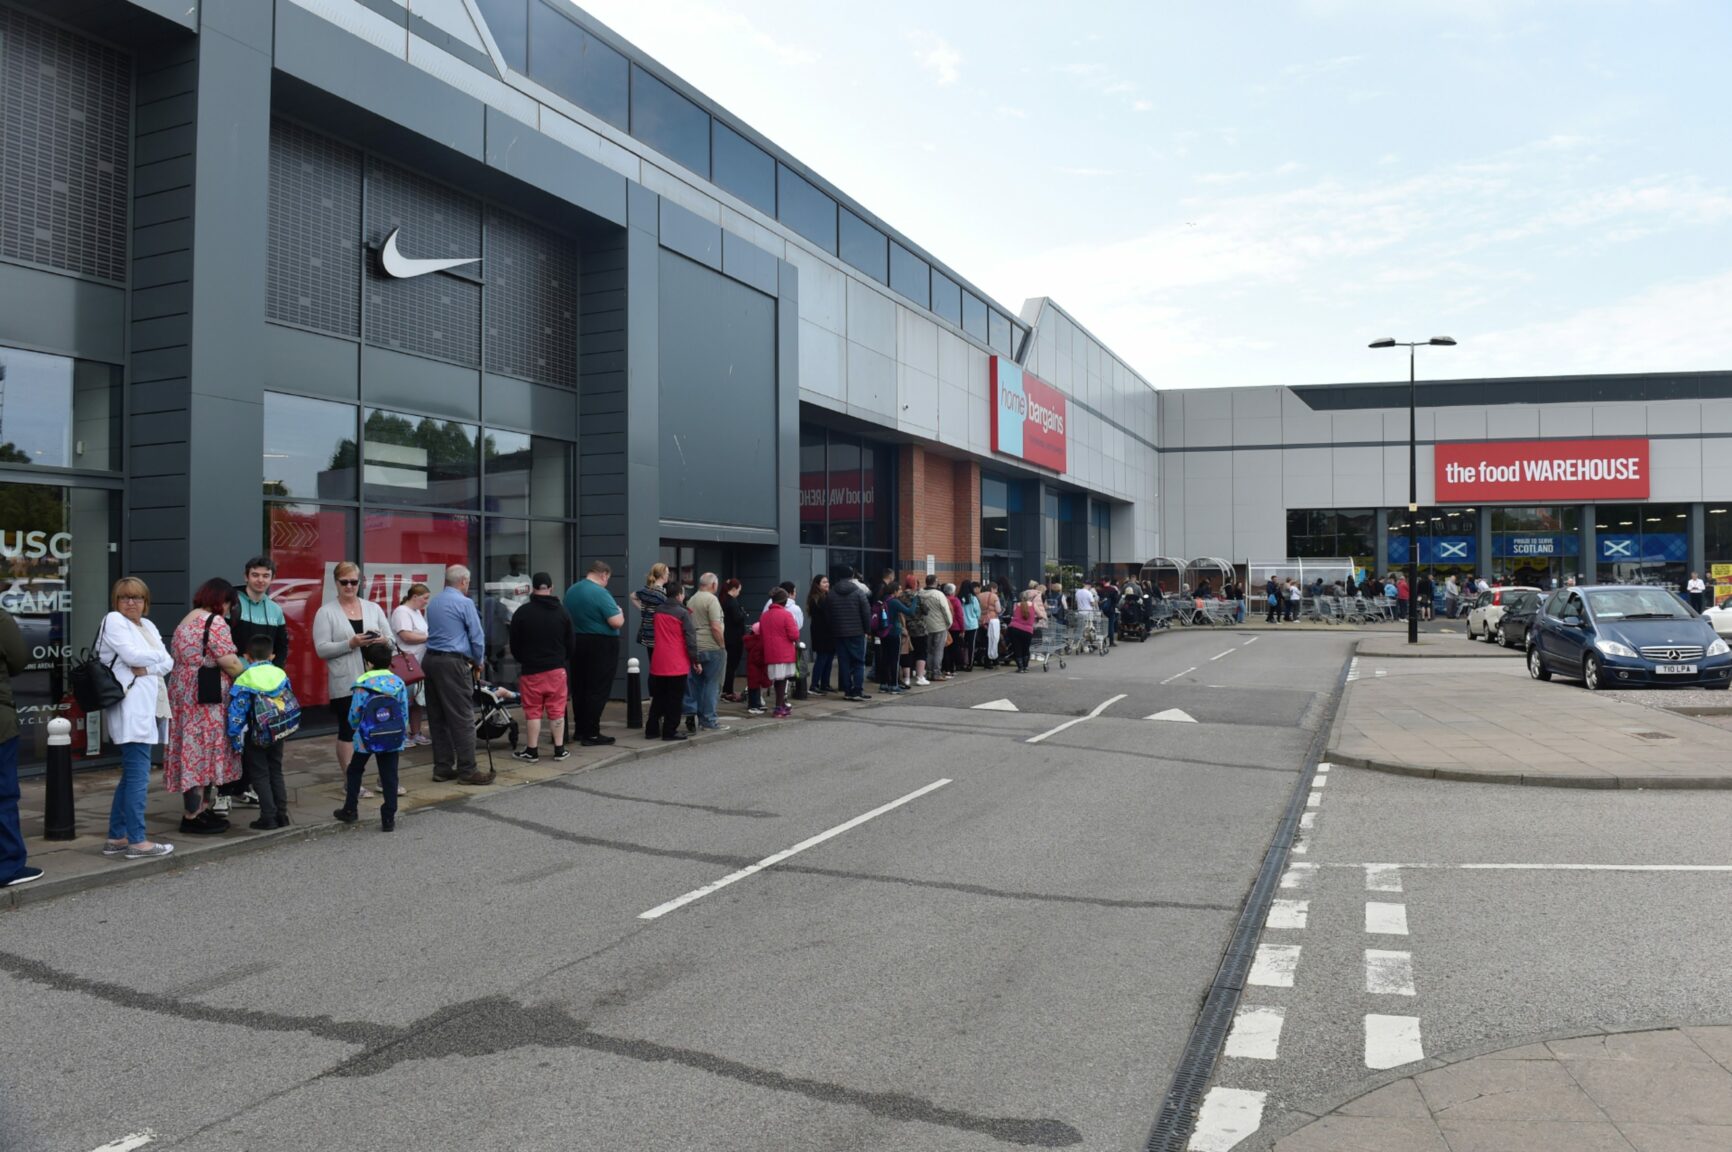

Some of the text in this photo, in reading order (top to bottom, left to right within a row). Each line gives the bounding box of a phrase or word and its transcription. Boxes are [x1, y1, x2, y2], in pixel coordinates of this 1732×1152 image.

[1001, 381, 1025, 415] home
[1028, 393, 1064, 435] bargains
[1446, 458, 1640, 483] the food WAREHOUSE
[0, 529, 73, 560] USC
[1513, 544, 1554, 554] SCOTLAND
[0, 590, 73, 614] GAME
[32, 645, 73, 660] ONG
[1676, 665, 1691, 673] LPA
[16, 703, 72, 714] VANS
